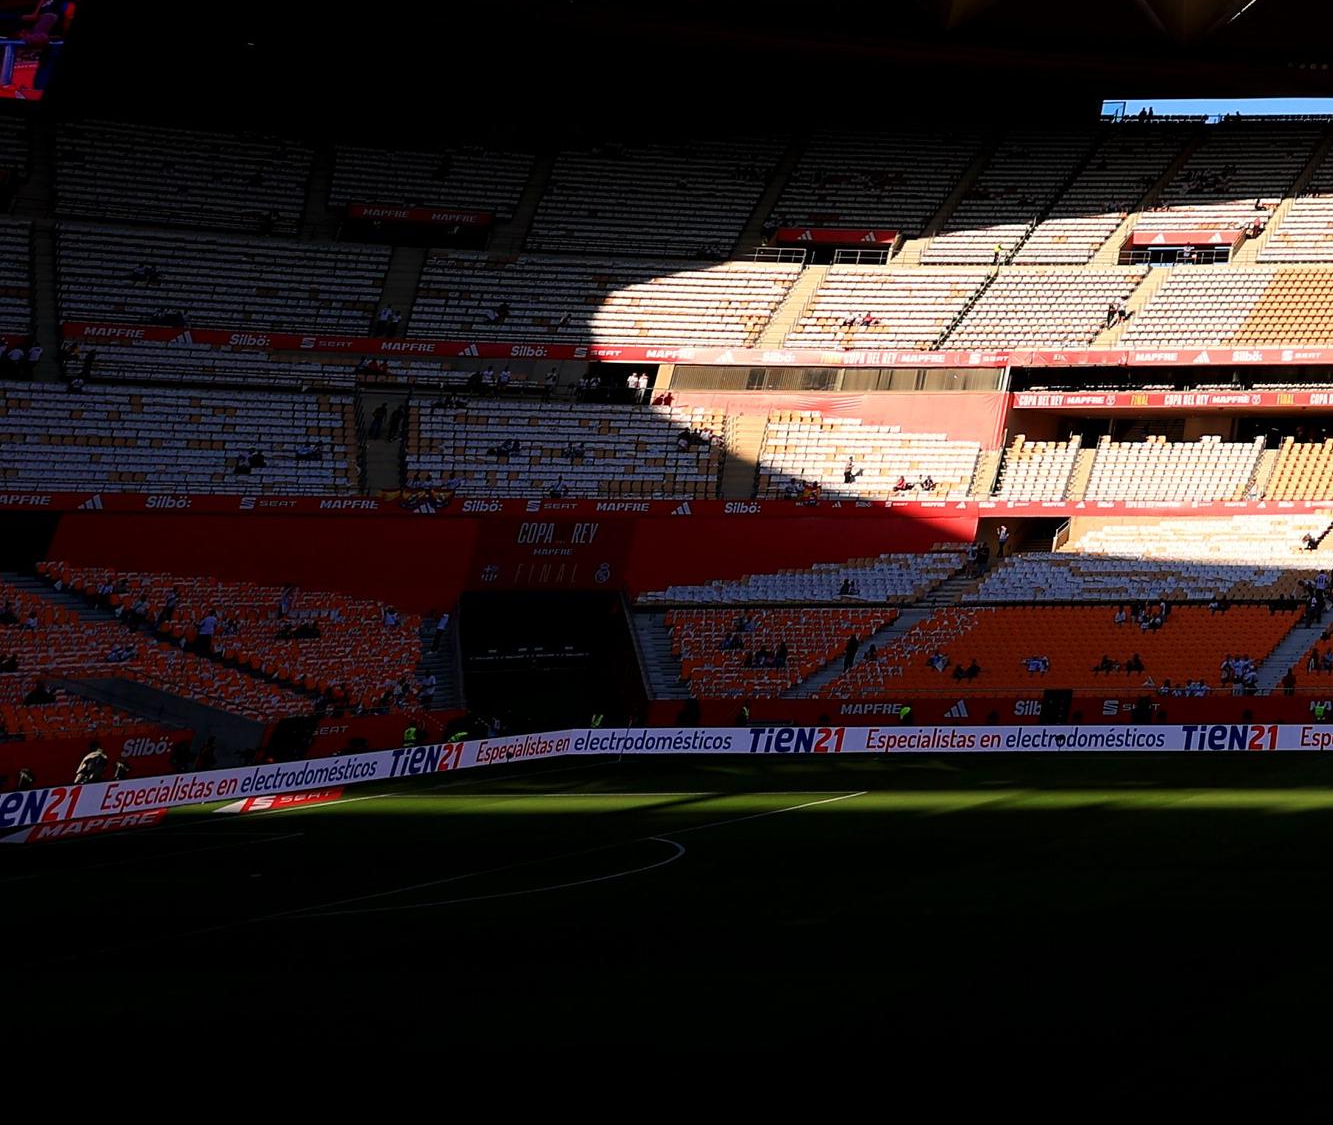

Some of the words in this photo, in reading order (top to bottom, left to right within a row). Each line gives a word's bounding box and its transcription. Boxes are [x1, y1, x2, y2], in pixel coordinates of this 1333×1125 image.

[363, 208, 409, 218] MAPFRE
[84, 327, 144, 339] MAPFRE
[228, 333, 270, 347] Silbö:
[381, 341, 435, 352] MAPFRE
[510, 345, 547, 357] Silbö:
[646, 349, 694, 359] MAPFRE
[902, 353, 945, 363] MAPFRE
[1067, 395, 1104, 405] MAPFRE
[1212, 395, 1249, 404] MAPFRE
[0, 495, 51, 505] APFRE
[145, 495, 192, 509] Silbö:
[320, 499, 379, 509] MAPFRE
[462, 500, 503, 512] Silbö:
[596, 503, 650, 512] MAPFRE
[724, 502, 761, 513] Silbö:
[518, 522, 555, 543] COPA
[571, 522, 599, 543] REY
[840, 703, 903, 715] MAPFRE
[1014, 700, 1042, 715] Silb
[120, 736, 173, 757] Silbö:
[866, 728, 975, 753] Especialistas
[980, 734, 1001, 748] en
[1006, 730, 1165, 748] electrodomésticos
[476, 735, 554, 765] Especialistas
[554, 738, 570, 751] en
[574, 731, 732, 751] electrodomésticos
[100, 776, 214, 811] Especialistas
[216, 778, 238, 795] en
[241, 759, 377, 793] electrodomésticos
[38, 811, 158, 838] MAPFRE
